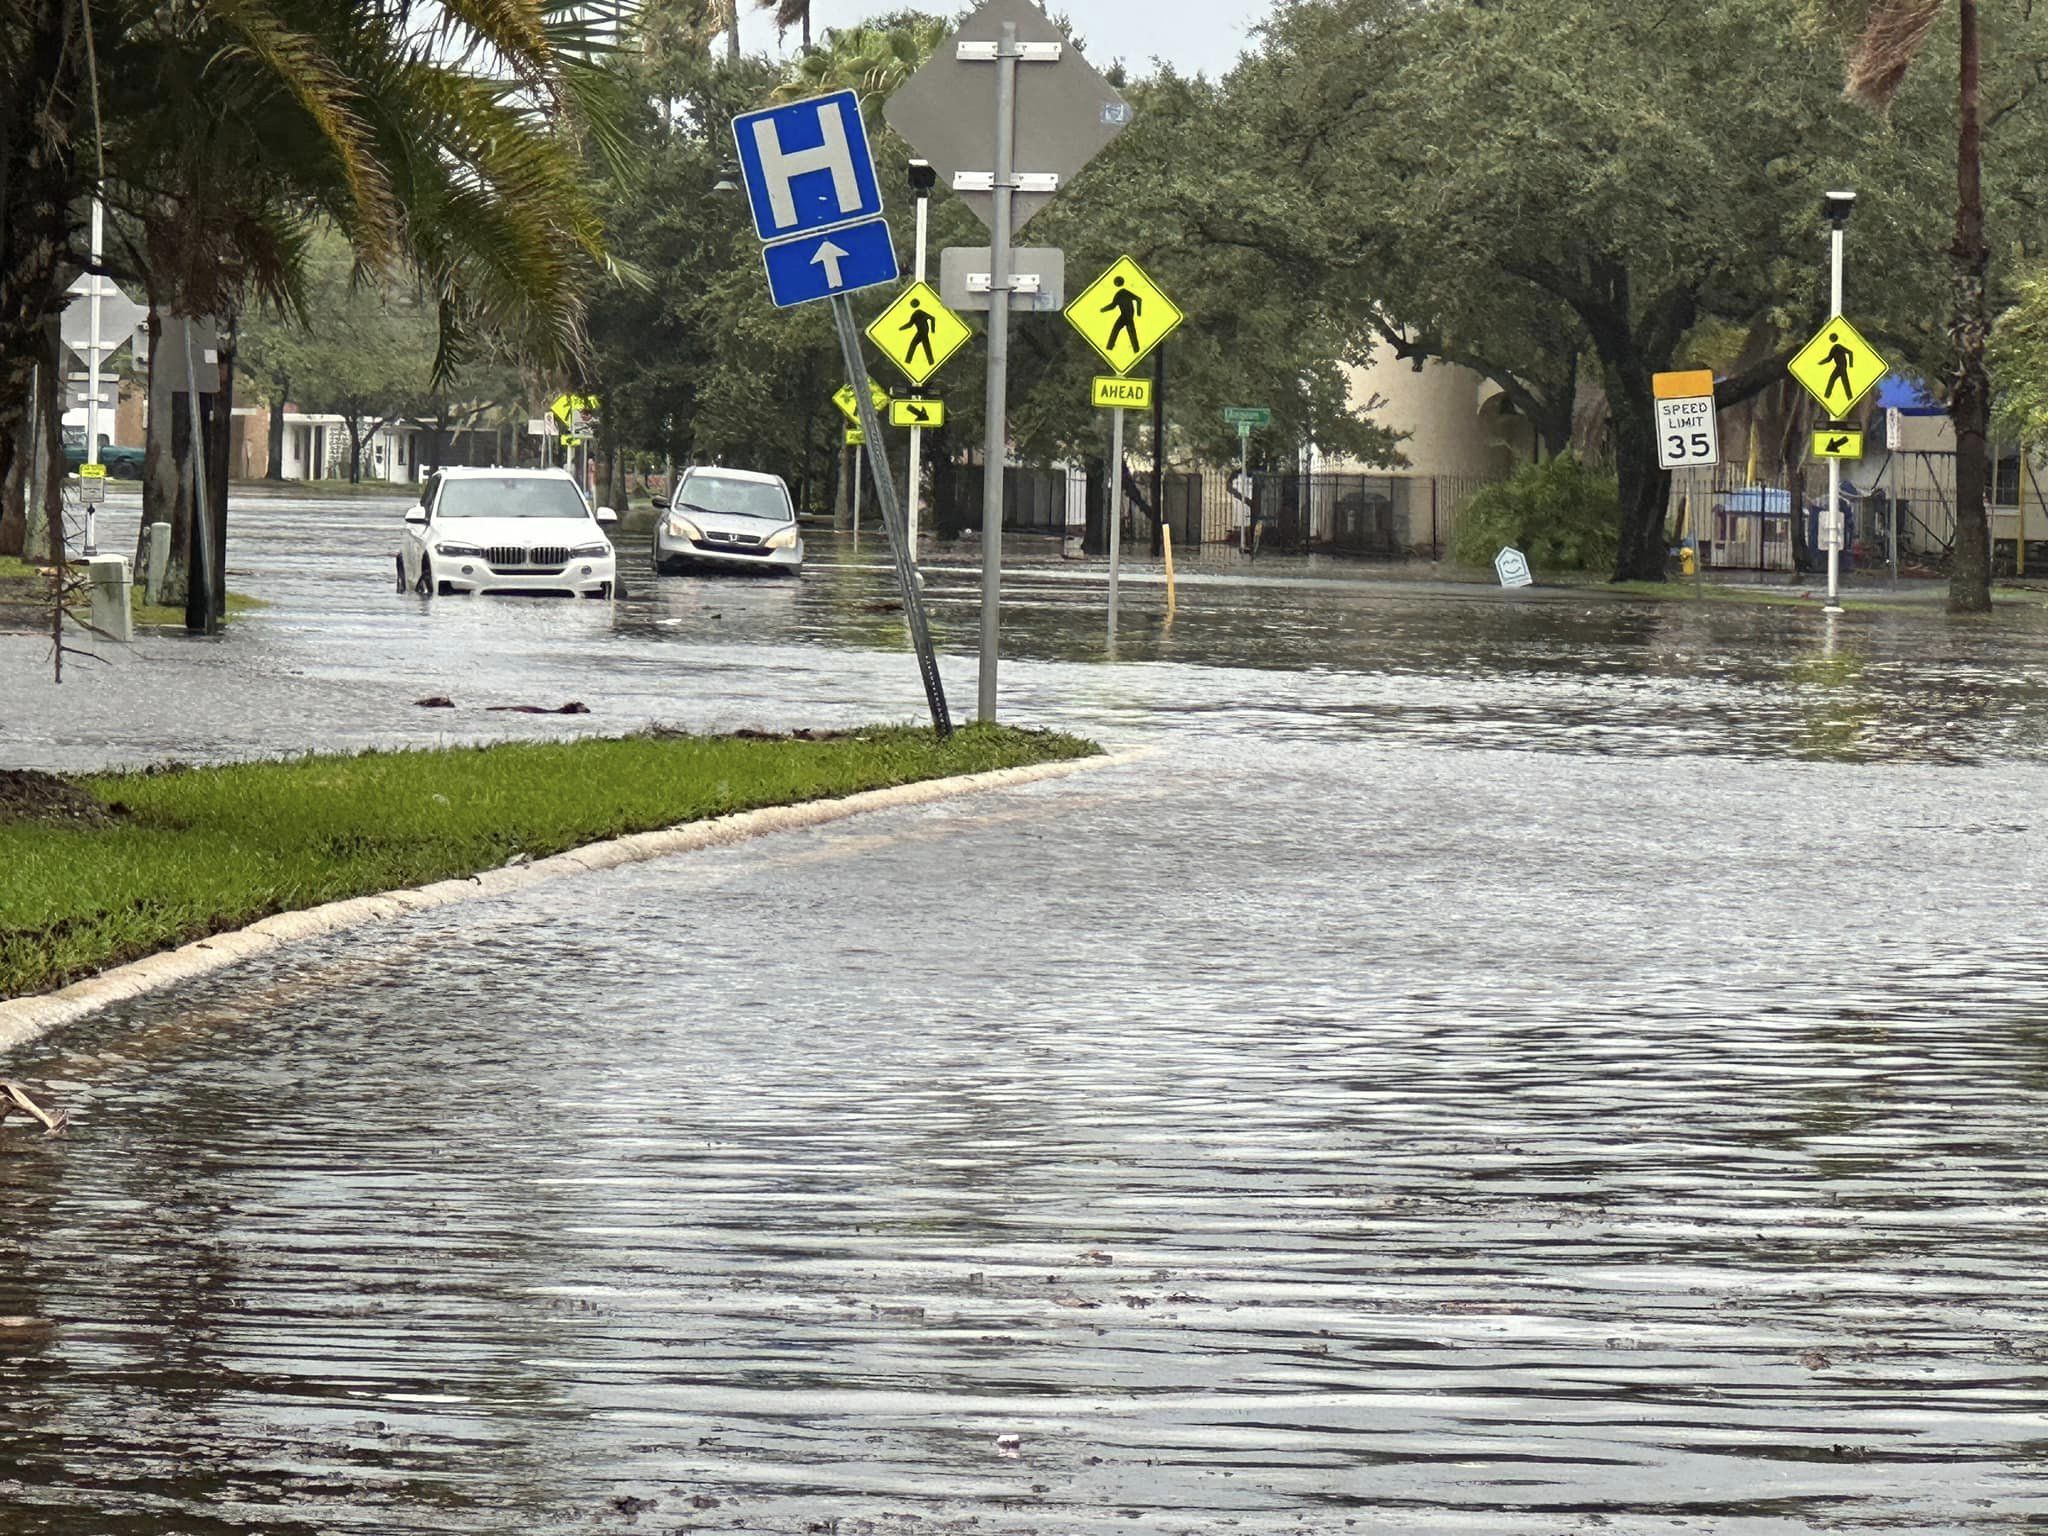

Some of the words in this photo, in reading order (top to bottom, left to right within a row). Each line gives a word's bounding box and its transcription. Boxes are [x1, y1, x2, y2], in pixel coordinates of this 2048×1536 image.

[752, 102, 863, 229] H
[1101, 384, 1143, 400] AHEAD
[1663, 402, 1708, 415] SPEED
[1669, 416, 1704, 429] LIMIT
[1668, 433, 1710, 458] 35
